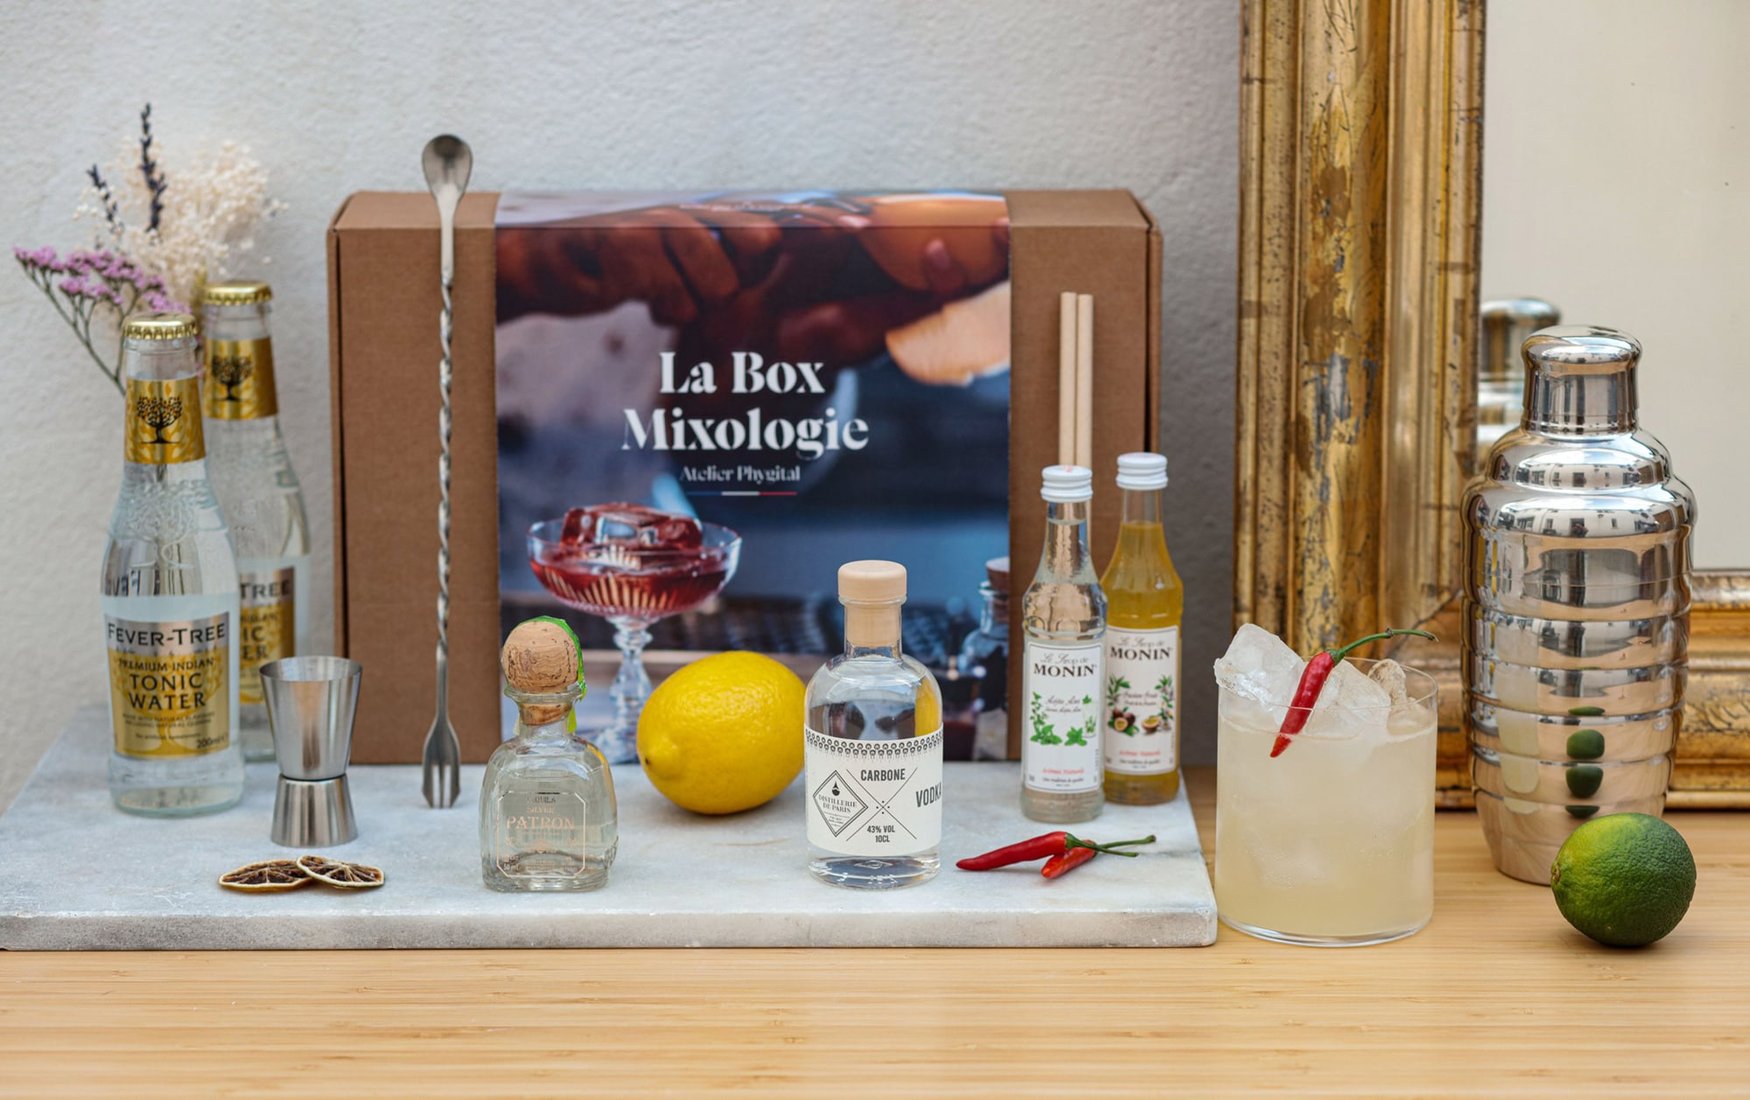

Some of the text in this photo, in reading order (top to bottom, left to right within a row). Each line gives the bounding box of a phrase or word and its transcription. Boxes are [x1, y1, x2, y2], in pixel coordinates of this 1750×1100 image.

[659, 351, 826, 394] La Box
[621, 407, 870, 461] Mixologie
[680, 465, 800, 485] Atelier Phygital
[240, 580, 290, 599] TREE
[107, 622, 226, 647] FEVER-TREE
[1110, 646, 1171, 661] MONIN
[118, 657, 215, 672] PREMIUM INDIAN
[1033, 662, 1095, 678] MONIN
[129, 672, 203, 691] TONIC
[128, 691, 206, 710] WATER
[860, 768, 906, 782] CARBONE
[831, 804, 852, 813] PARIS
[867, 825, 895, 833] 43% VOL
